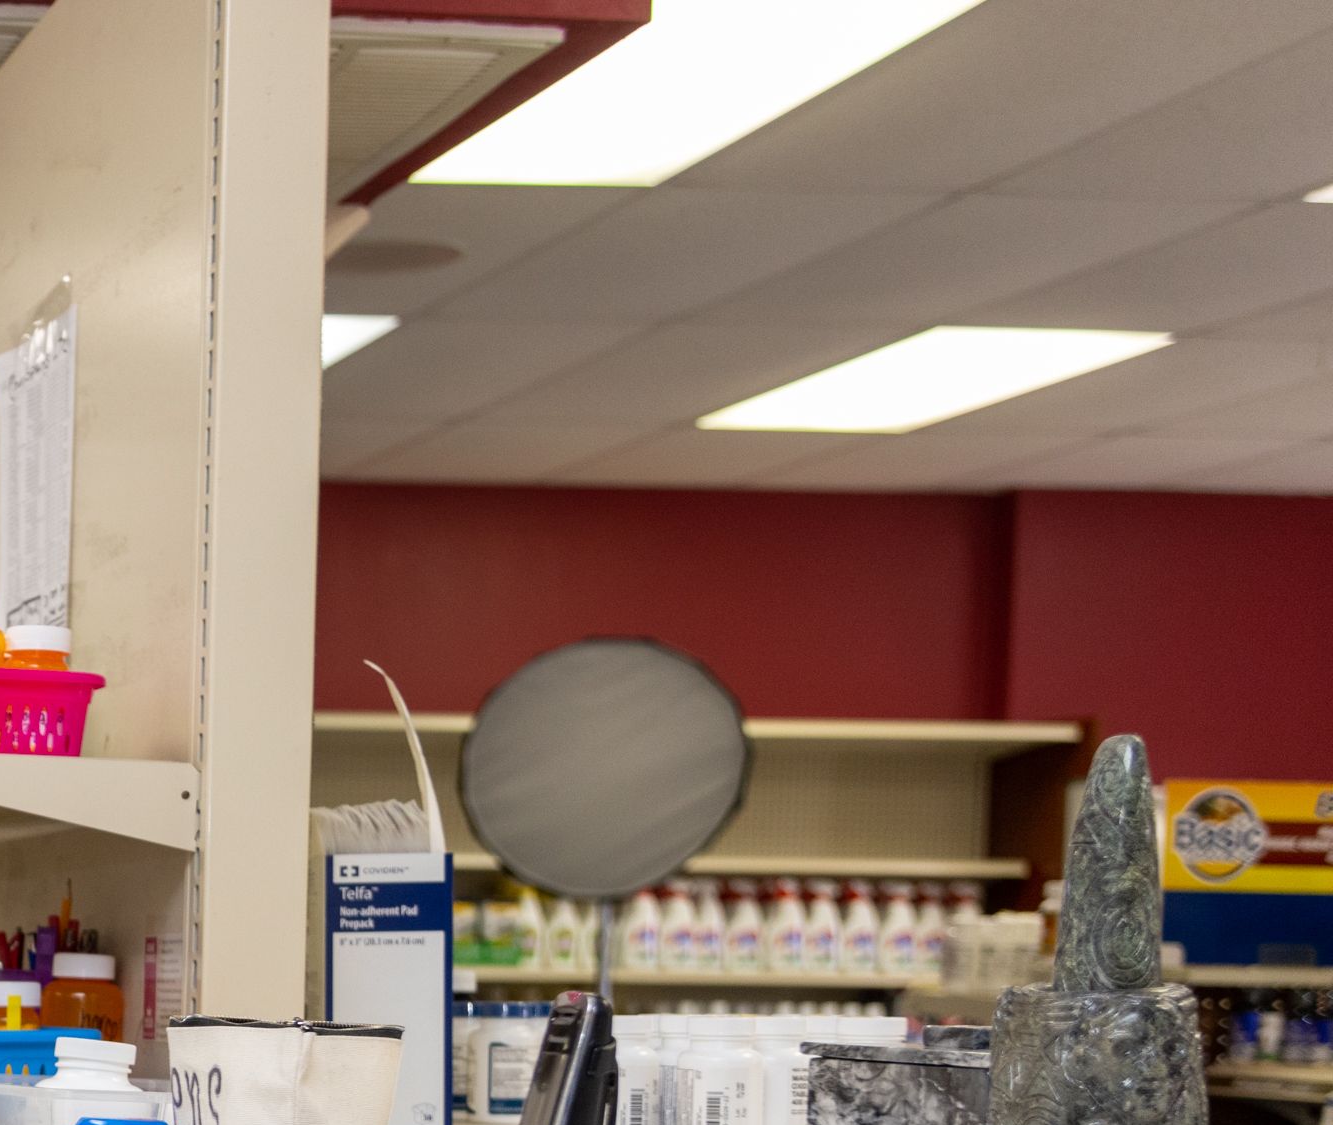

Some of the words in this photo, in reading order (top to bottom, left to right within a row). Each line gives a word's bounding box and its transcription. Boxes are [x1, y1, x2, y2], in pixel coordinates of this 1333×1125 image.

[1176, 818, 1261, 851] Basic
[339, 905, 400, 917] Non-adherent
[401, 904, 418, 916] Pad
[339, 918, 374, 930] Prepack
